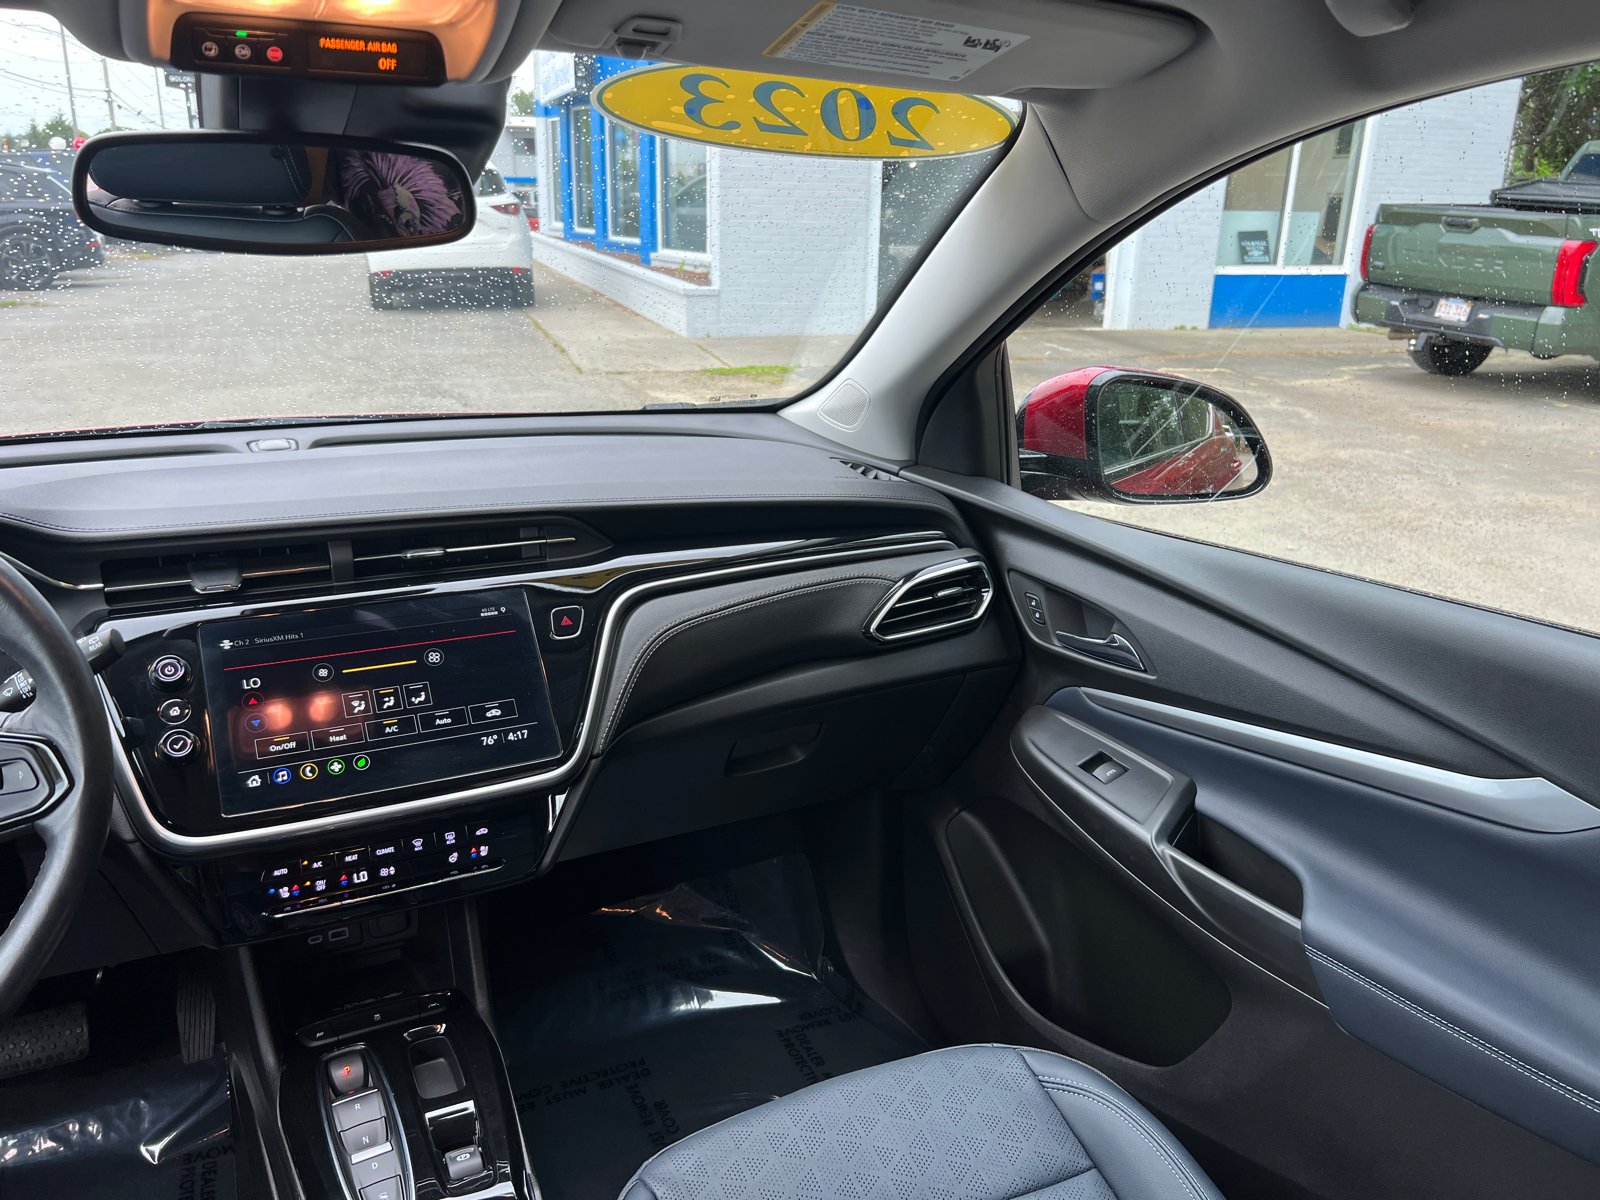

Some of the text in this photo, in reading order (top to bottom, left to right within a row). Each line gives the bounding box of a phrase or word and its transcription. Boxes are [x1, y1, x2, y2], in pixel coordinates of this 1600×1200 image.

[319, 37, 366, 51] PASSENGER
[378, 57, 397, 71] OFF
[234, 639, 244, 647] Ch
[254, 634, 285, 644] SiriusXM
[285, 633, 299, 641] Hits
[242, 677, 261, 690] LO
[385, 725, 399, 733] A/C
[329, 734, 347, 743] Heat
[507, 730, 528, 741] 4:17
[269, 741, 297, 752] On/Off
[273, 868, 288, 876] AUTO
[795, 1033, 826, 1068] DEALER
[343, 1065, 351, 1075] P
[514, 1057, 647, 1102] PROTECTIVE COV
[545, 1067, 652, 1106] DEALER MUST
[362, 1136, 369, 1144] N
[371, 1161, 378, 1169] D
